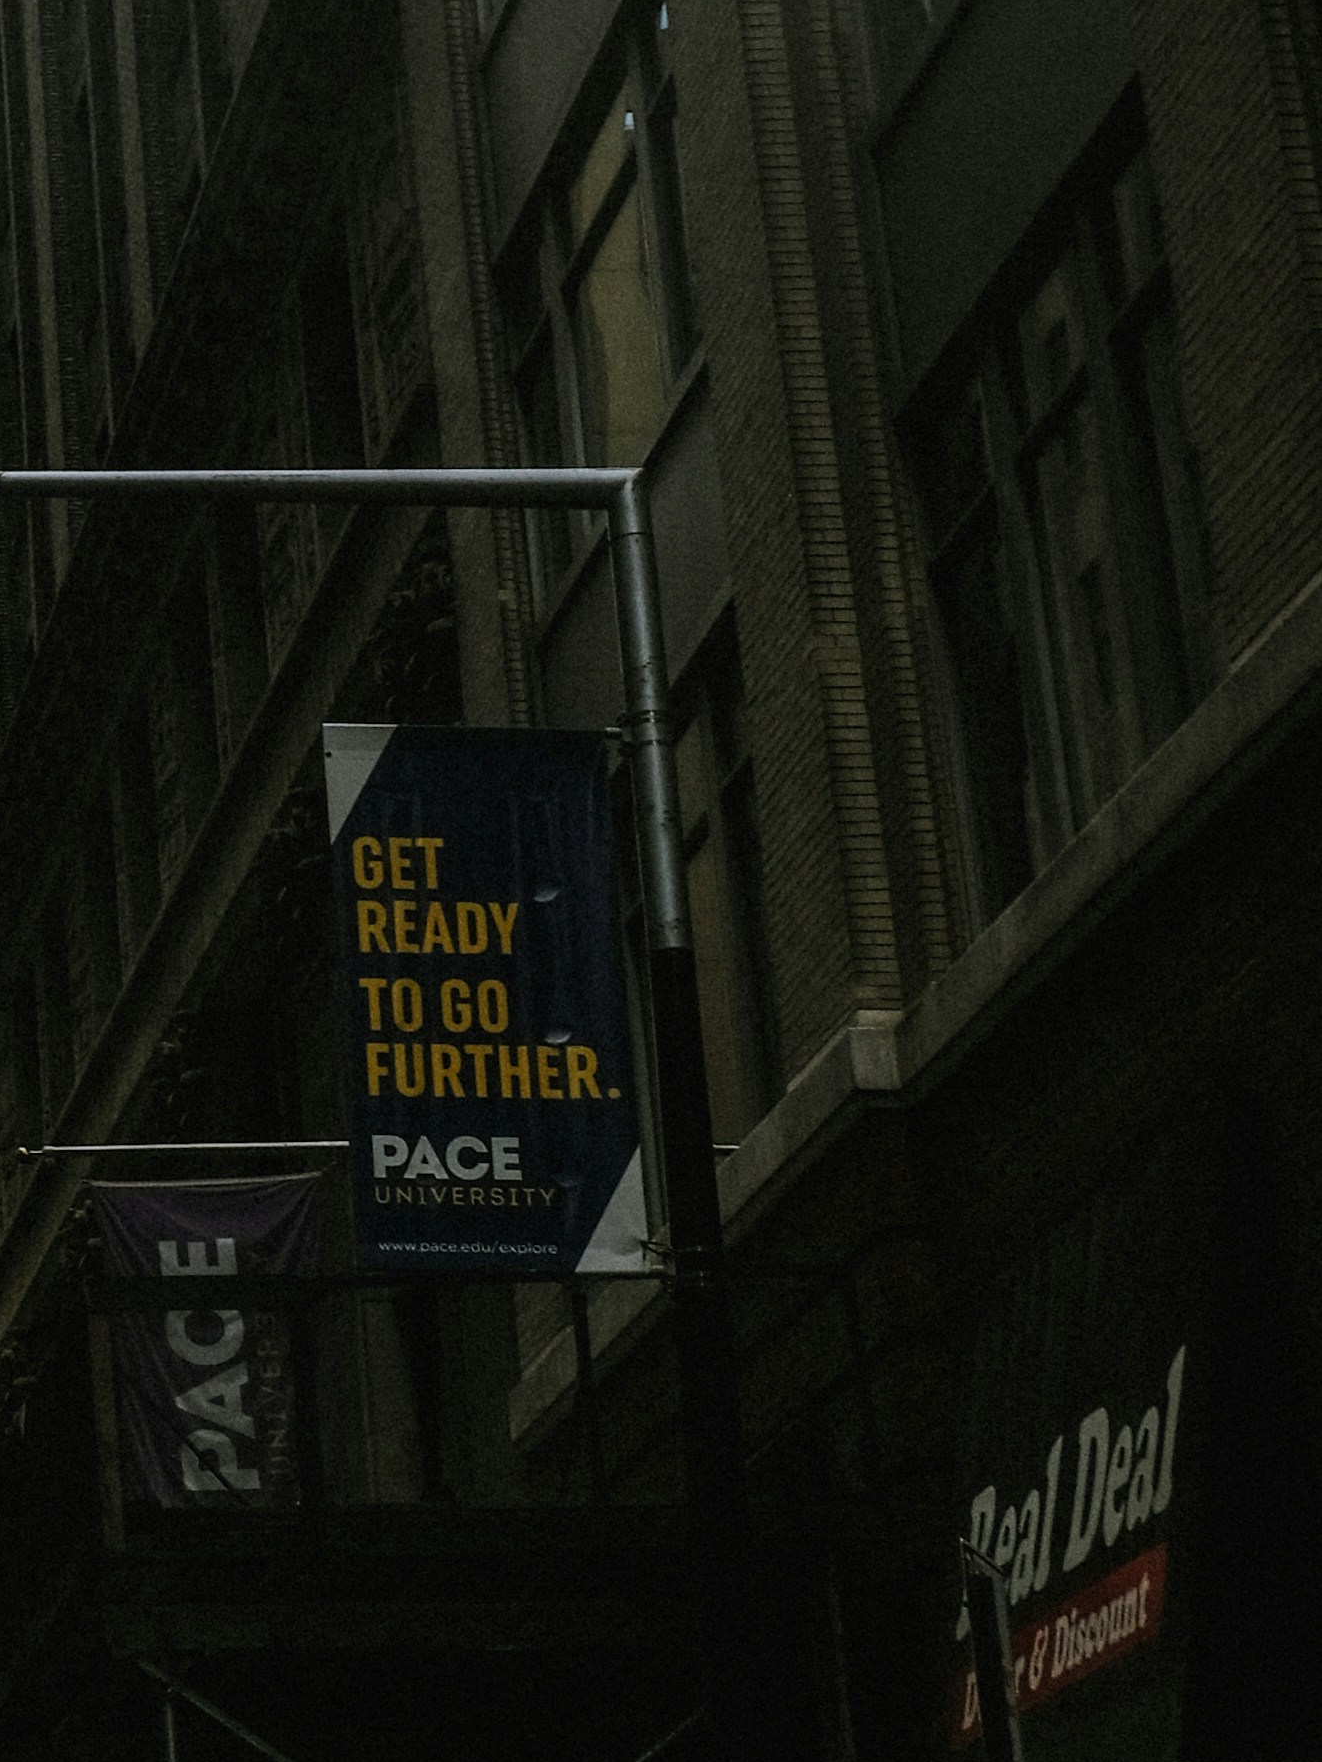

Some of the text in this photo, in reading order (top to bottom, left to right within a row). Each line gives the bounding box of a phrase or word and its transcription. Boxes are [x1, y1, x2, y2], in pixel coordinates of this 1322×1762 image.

[352, 836, 444, 891] GET
[356, 899, 519, 955] READY
[359, 977, 510, 1034] TO GO
[365, 1042, 621, 1100] FURTHER.
[371, 1134, 523, 1182] PACE
[373, 1186, 556, 1207] UNIVERSITY
[377, 1240, 557, 1257] www.pace.edu/explore
[158, 1237, 260, 1491] PACE
[1061, 1344, 1187, 1573] Deal
[1050, 1573, 1151, 1679] Discount
